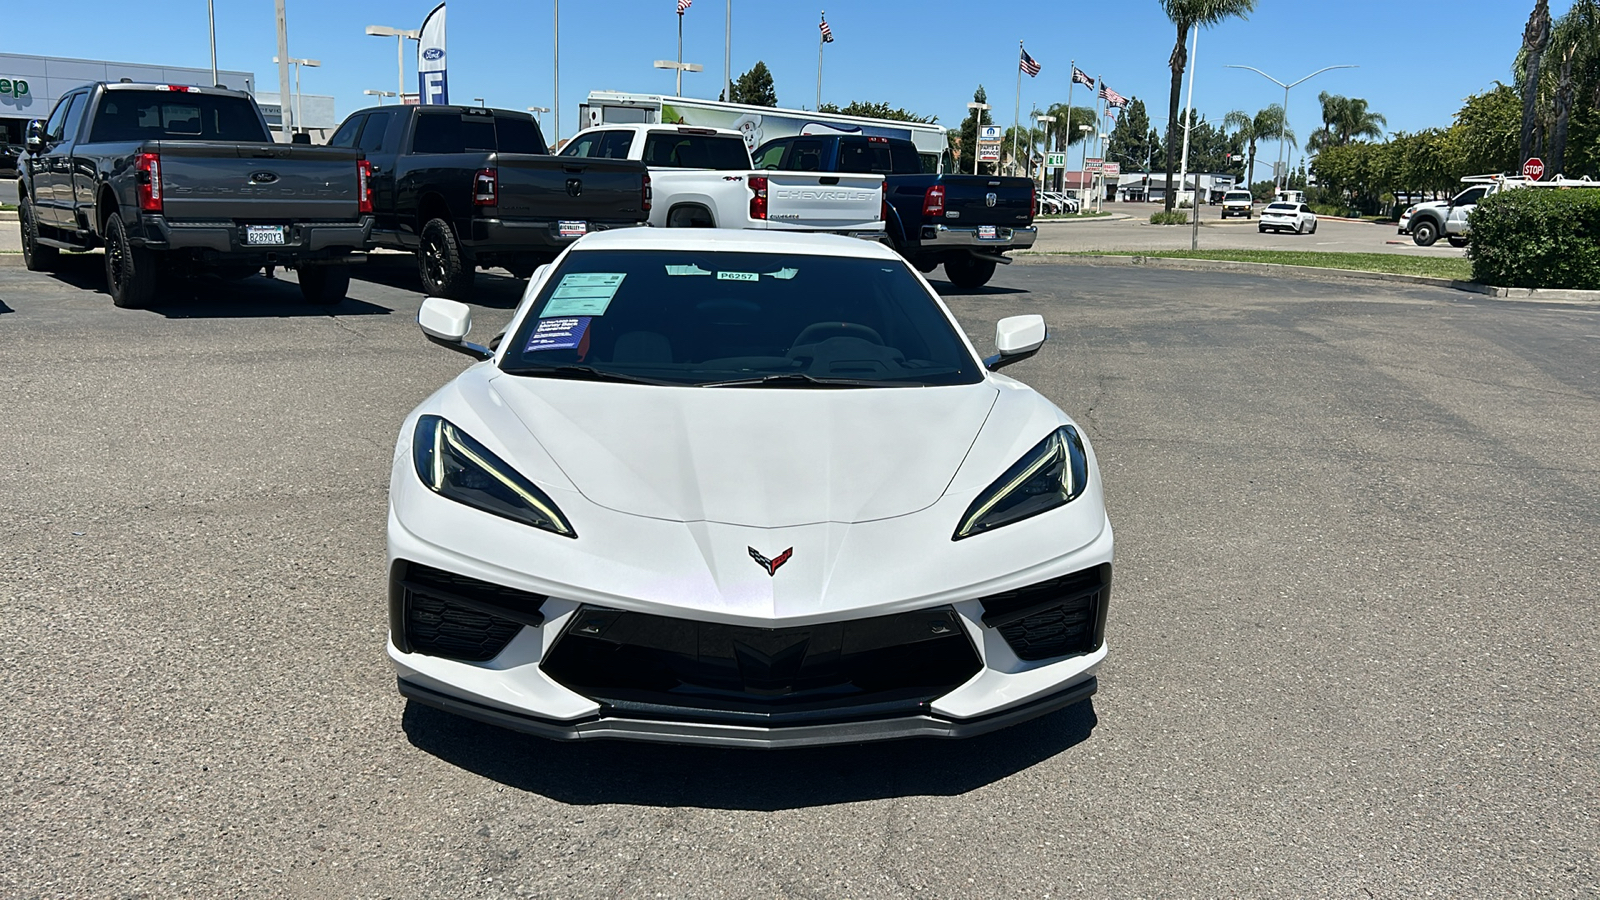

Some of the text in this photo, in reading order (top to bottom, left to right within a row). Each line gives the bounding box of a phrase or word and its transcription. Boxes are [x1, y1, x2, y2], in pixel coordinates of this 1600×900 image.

[1524, 165, 1543, 175] STOP
[175, 186, 348, 196] SUPER DUTY
[776, 190, 875, 201] CHEVROLET
[250, 232, 282, 242] 82890Y3
